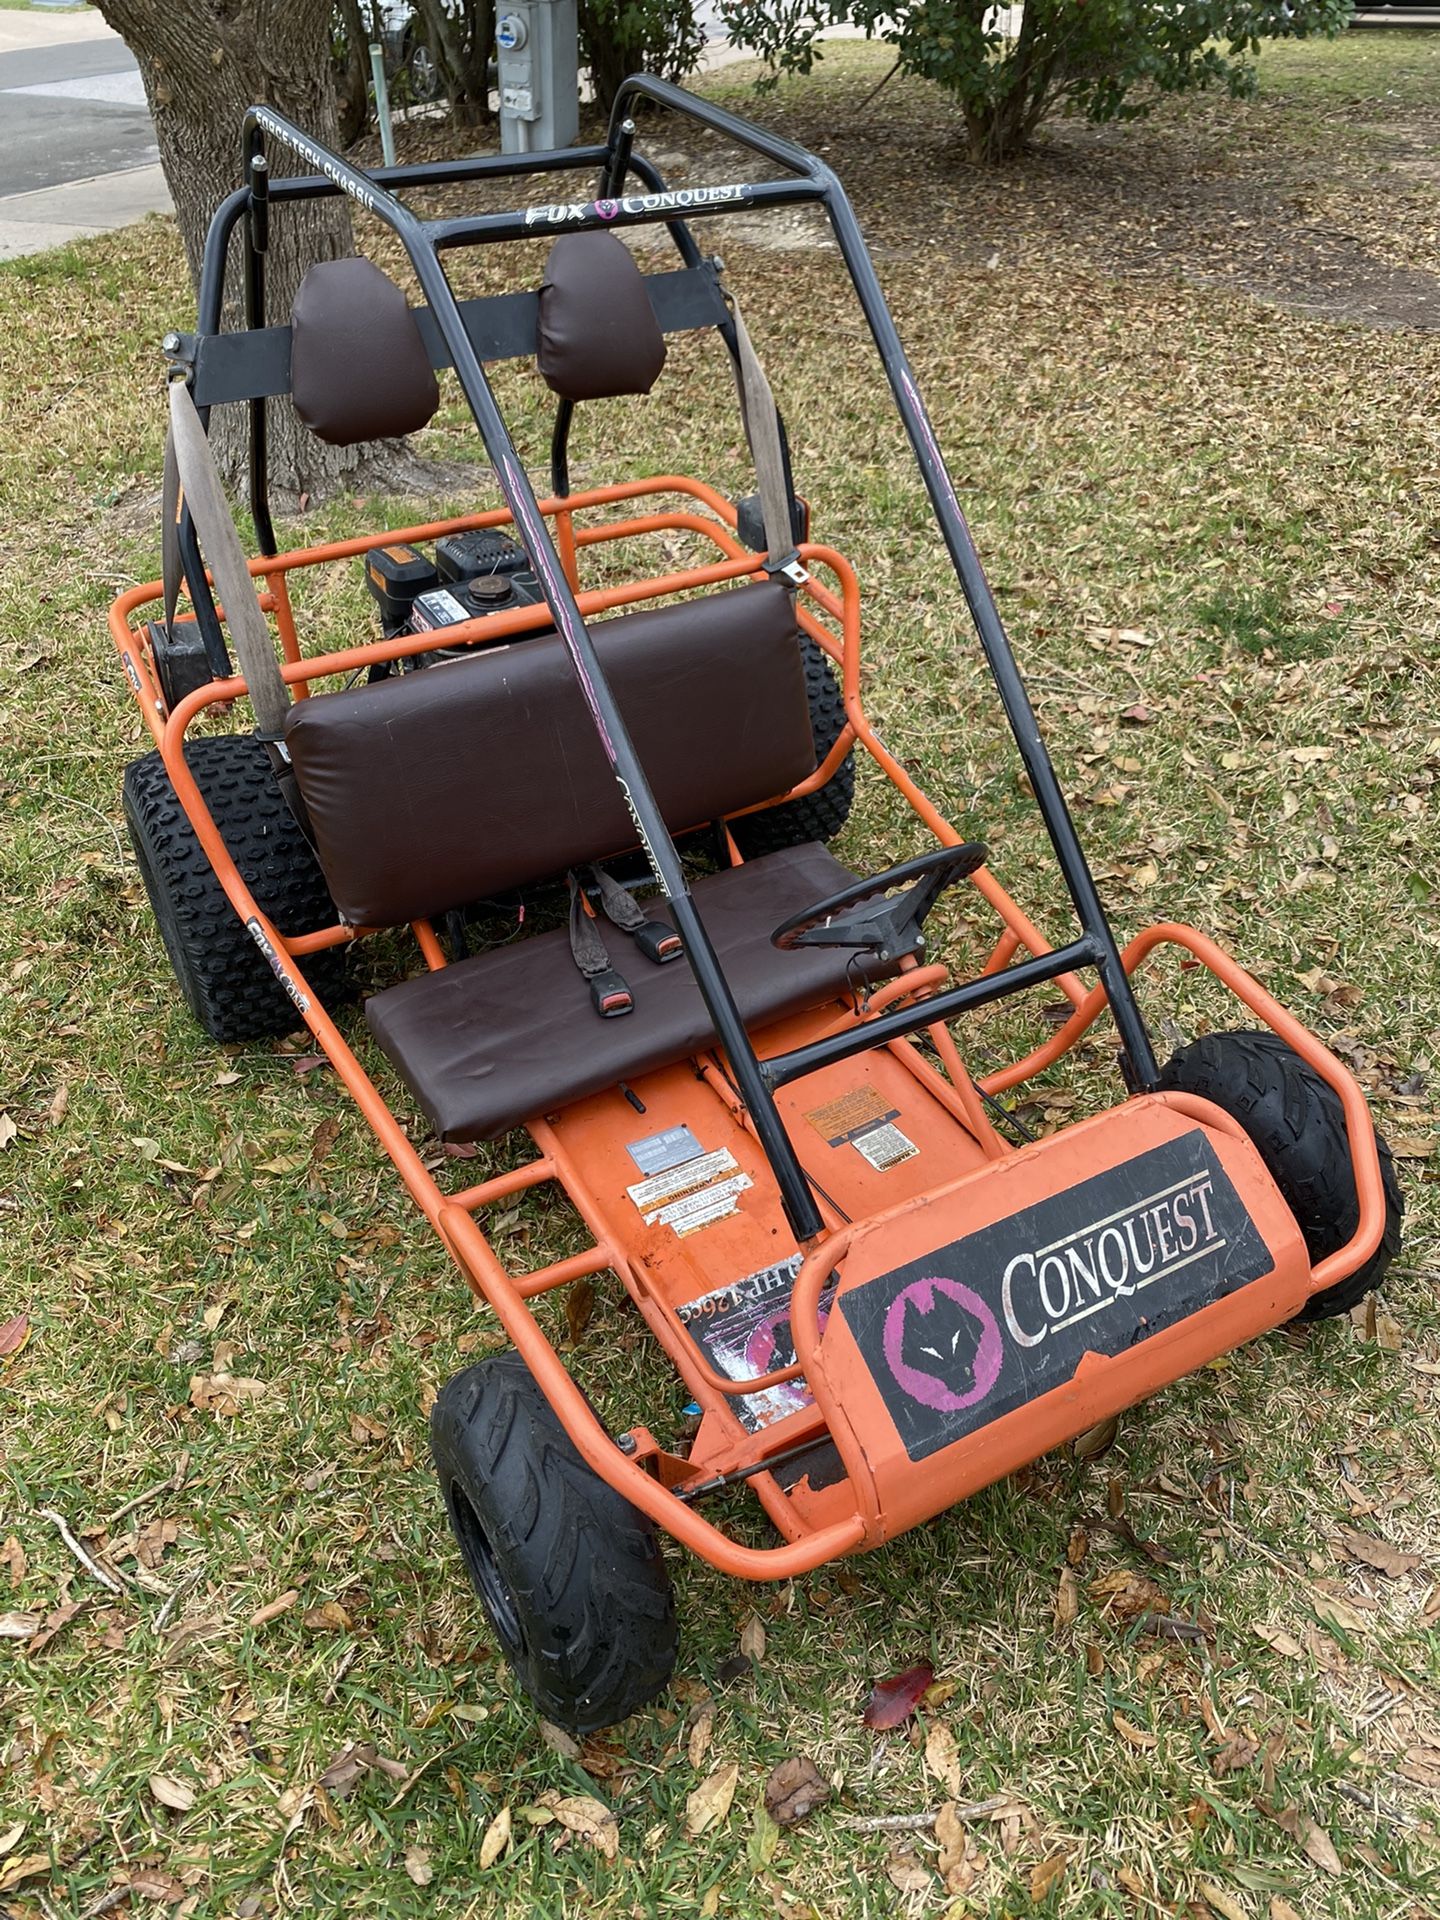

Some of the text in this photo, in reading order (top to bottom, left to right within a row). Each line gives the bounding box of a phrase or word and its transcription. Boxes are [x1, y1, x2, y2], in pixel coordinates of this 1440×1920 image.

[525, 184, 748, 225] FOX CONQUEST
[668, 1182, 706, 1202] WARNING
[750, 1268, 786, 1297] HP
[1001, 1180, 1218, 1348] CONQUEST
[679, 1288, 744, 1325] 126cc
